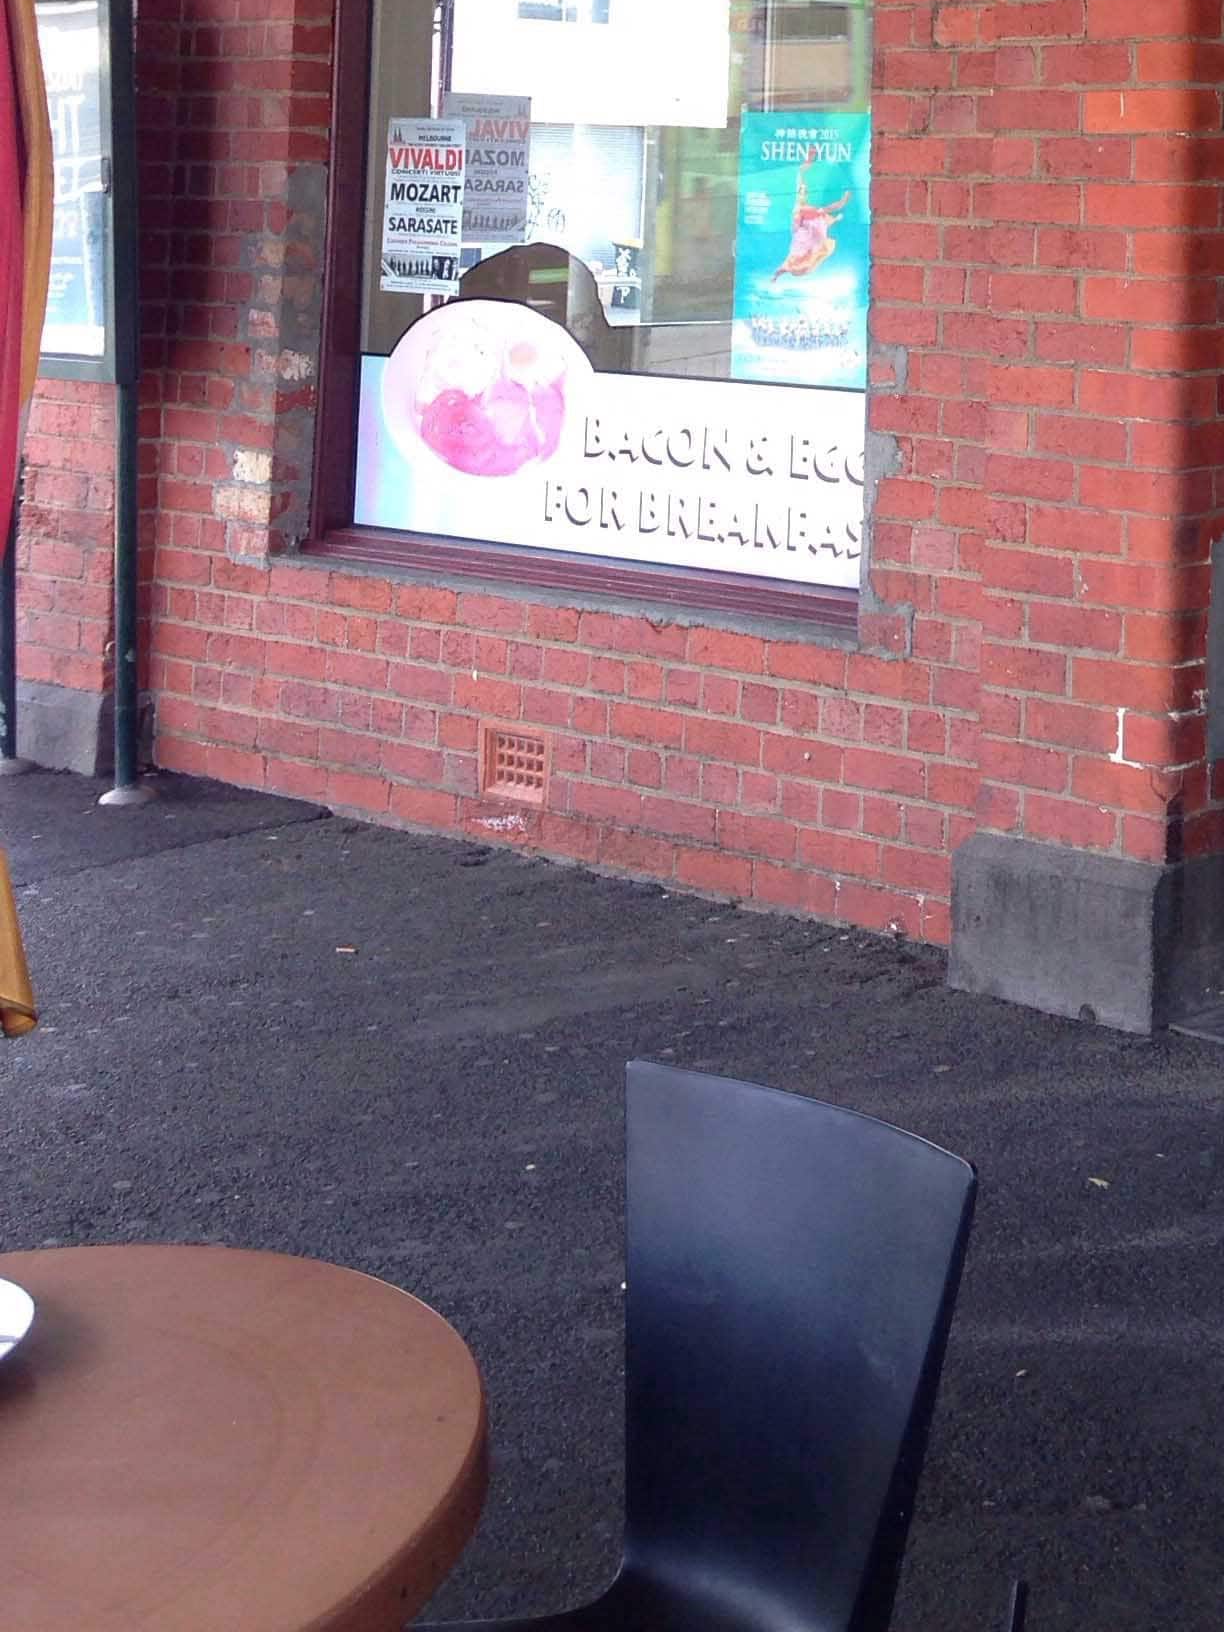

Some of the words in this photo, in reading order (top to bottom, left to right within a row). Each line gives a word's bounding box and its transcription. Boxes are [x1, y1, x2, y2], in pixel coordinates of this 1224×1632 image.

[389, 147, 463, 170] VIVALDI
[760, 141, 810, 161] SHEN
[813, 142, 852, 162] YUN
[390, 183, 462, 204] MOZART
[388, 216, 458, 235] SARASATE
[584, 417, 731, 472] BACON
[544, 480, 625, 531] FOR
